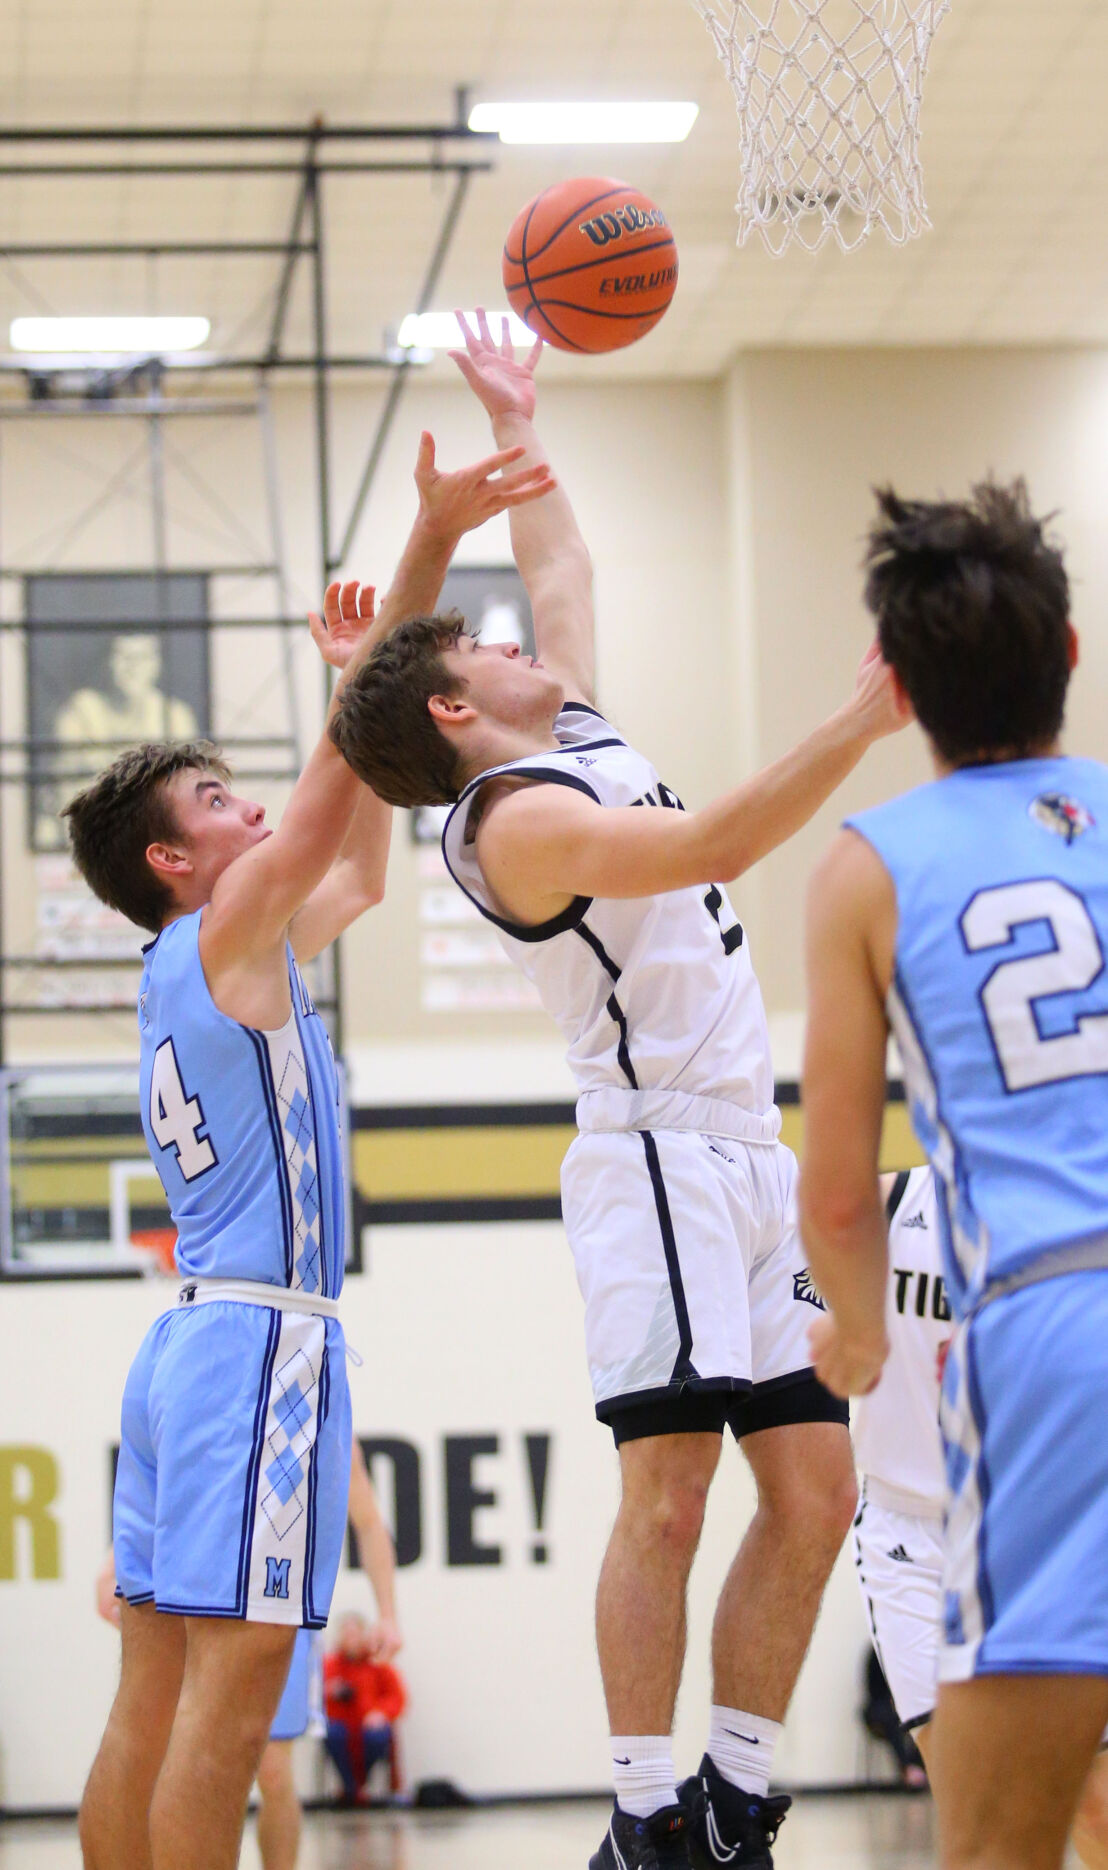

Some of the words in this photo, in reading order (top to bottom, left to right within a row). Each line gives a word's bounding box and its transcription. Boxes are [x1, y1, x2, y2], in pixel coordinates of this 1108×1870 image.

[579, 203, 665, 247] Wilso
[957, 875, 1108, 1095] 2
[150, 1034, 220, 1184] 4
[0, 1443, 61, 1582] R
[263, 1556, 292, 1599] M
